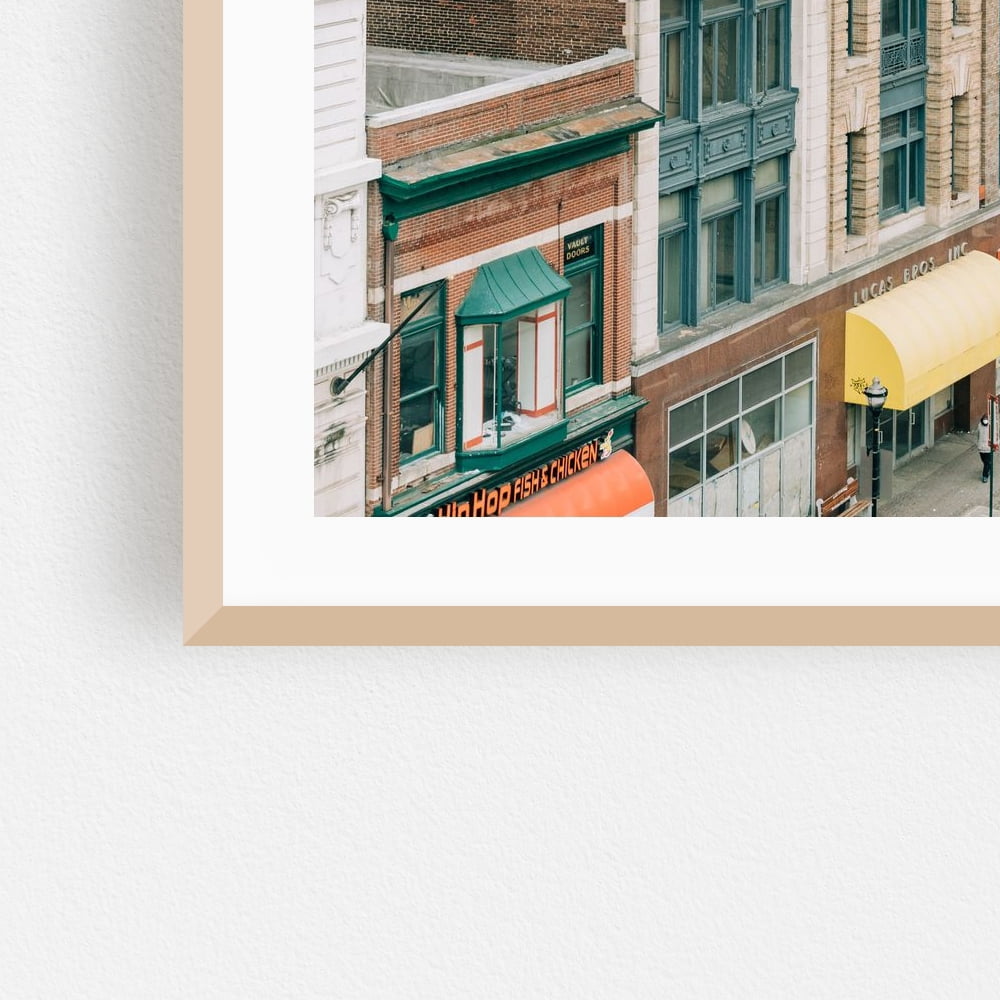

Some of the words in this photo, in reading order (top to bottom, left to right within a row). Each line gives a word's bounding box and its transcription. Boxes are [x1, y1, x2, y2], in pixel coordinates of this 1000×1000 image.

[566, 245, 590, 260] DOORS
[567, 236, 588, 250] VAULT
[853, 276, 893, 307] LUCAS
[903, 256, 936, 284] BROS
[948, 242, 968, 263] INC
[513, 469, 540, 504] FISH
[541, 464, 549, 489] &
